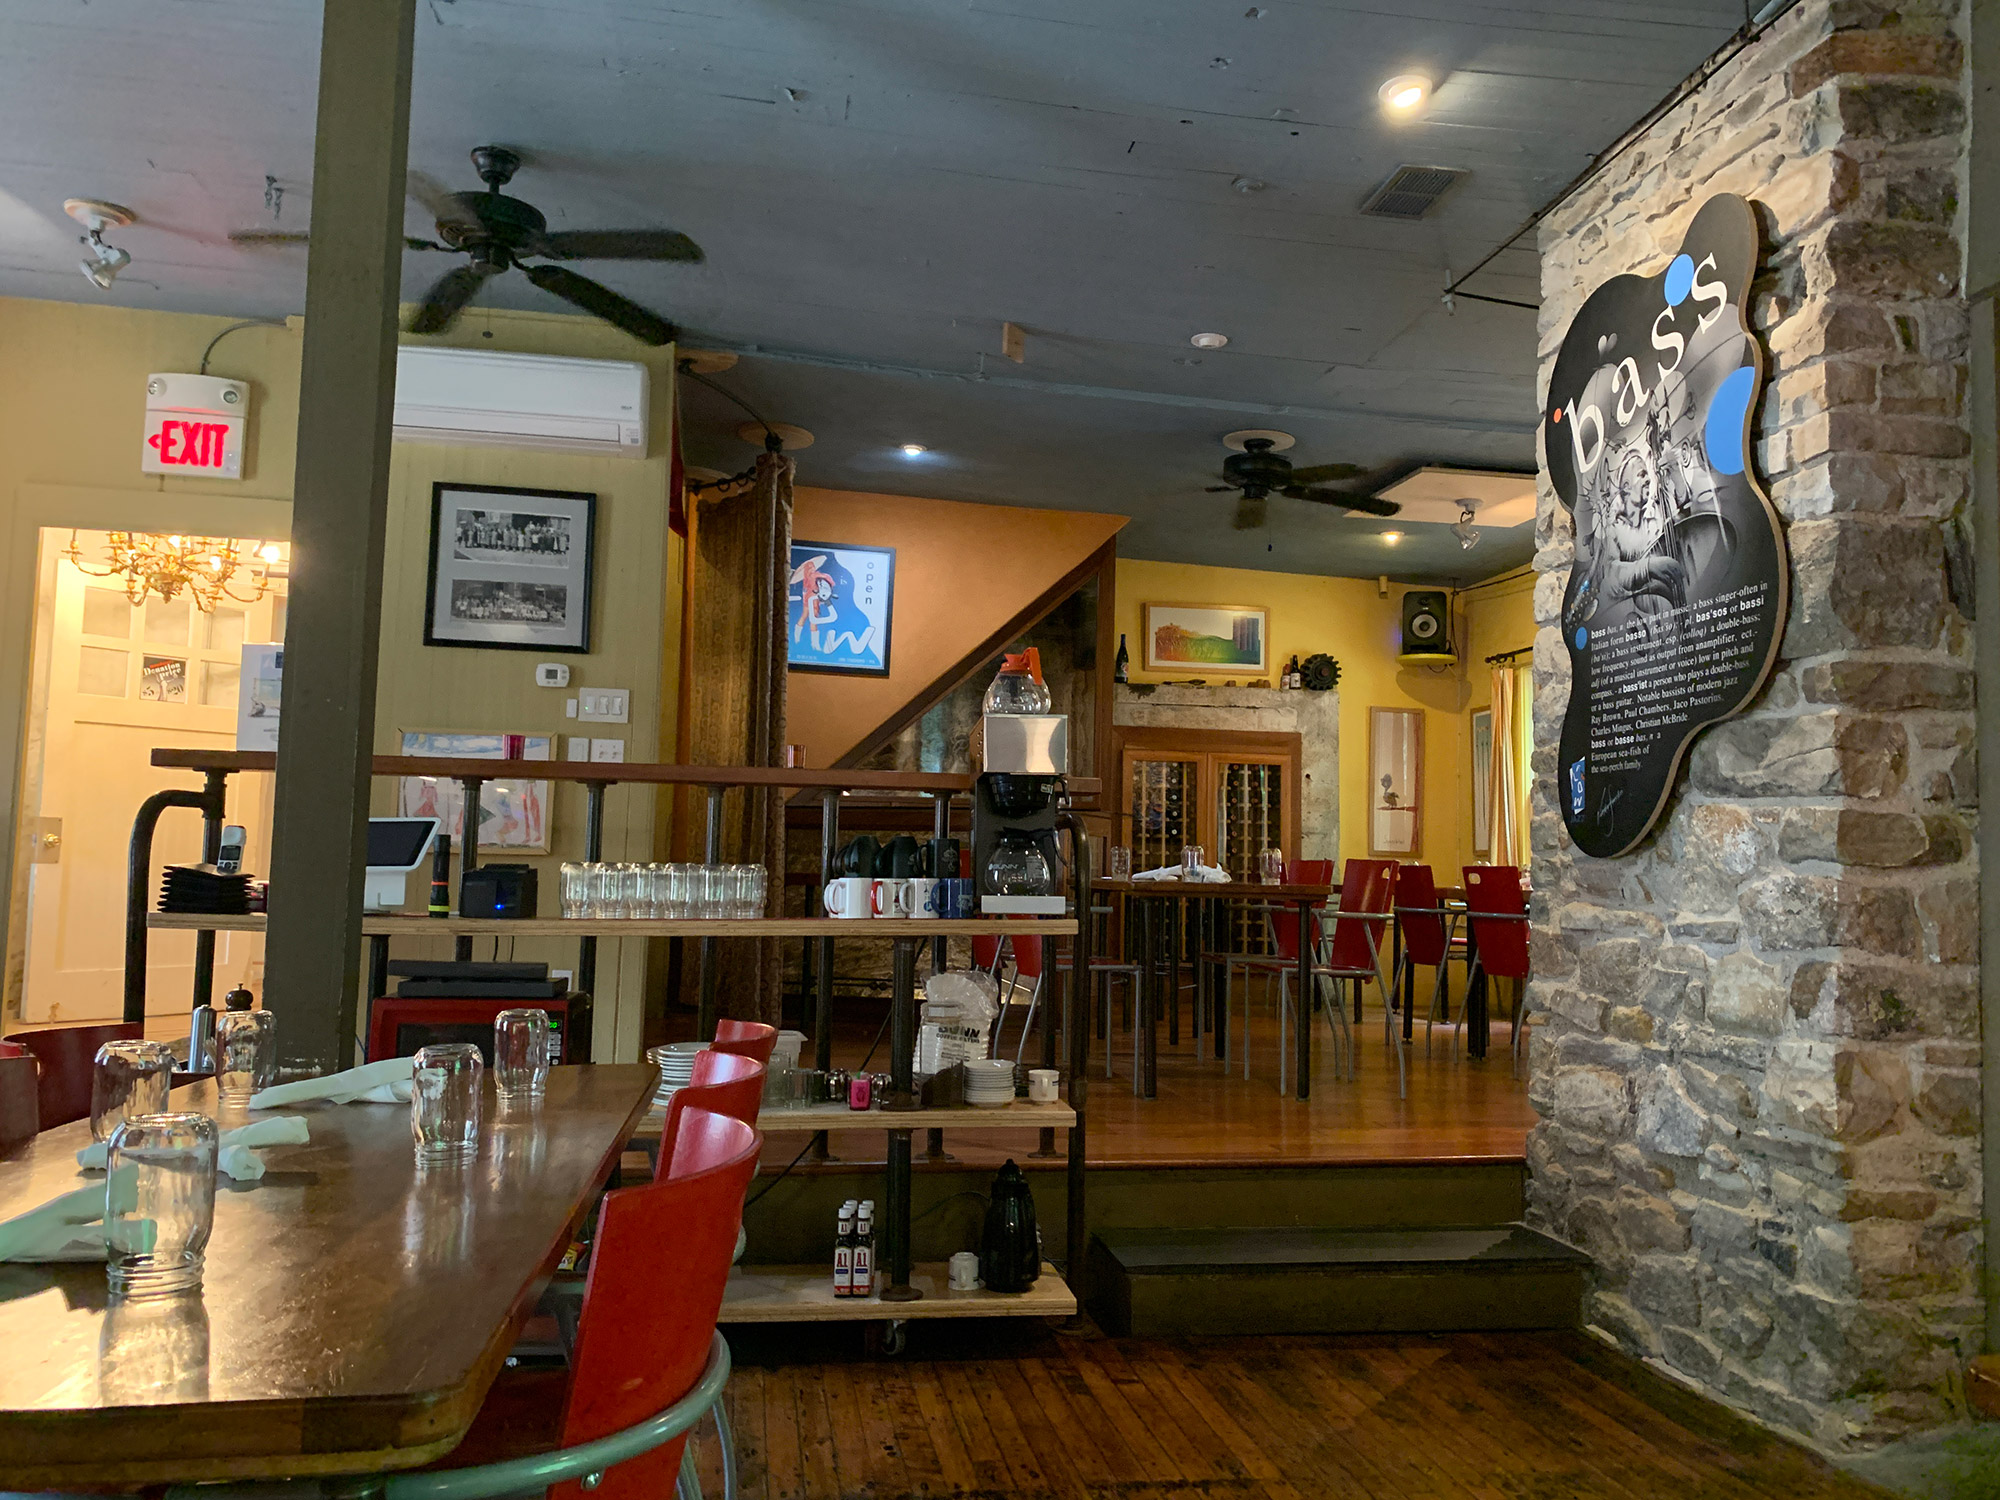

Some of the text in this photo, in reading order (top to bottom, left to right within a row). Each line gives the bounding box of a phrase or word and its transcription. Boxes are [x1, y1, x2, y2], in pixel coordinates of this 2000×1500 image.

[1563, 252, 1728, 474] bass
[160, 420, 230, 467] EXIT
[863, 562, 876, 605] open
[1591, 628, 1606, 639] bass
[1626, 619, 1636, 628] the
[1649, 612, 1661, 624] part
[1662, 609, 1669, 618] in
[1698, 598, 1714, 608] bass
[1715, 584, 1758, 604] singer-often
[1760, 580, 1768, 591] in
[1592, 640, 1609, 651] Italian
[1610, 636, 1624, 646] form
[1626, 630, 1646, 642] basso
[1696, 607, 1728, 622] bas'sos
[1730, 604, 1738, 614] or
[1740, 594, 1764, 610] bassi
[1590, 678, 1600, 688] adj
[1600, 675, 1609, 687] (of
[1614, 669, 1636, 682] musical
[1636, 663, 1668, 678] instrument
[1668, 662, 1676, 670] or
[1678, 656, 1698, 668] voice)
[1699, 654, 1711, 664] low
[1712, 650, 1720, 660] in
[1721, 646, 1738, 660] pitch
[1740, 642, 1754, 654] and
[1591, 667, 1601, 676] low
[1602, 660, 1629, 673] frequency
[1630, 654, 1648, 666] sound
[1656, 648, 1677, 660] output
[1678, 644, 1694, 655] from
[1616, 648, 1628, 657] bass
[1653, 676, 1672, 689] person
[1674, 672, 1686, 682] who
[1688, 670, 1704, 682] plays
[1710, 660, 1750, 674] double-bass
[1602, 701, 1614, 710] bass
[1637, 691, 1660, 704] Notable
[1662, 686, 1686, 698] bassists
[1687, 682, 1696, 694] of
[1696, 680, 1722, 692] modern
[1722, 676, 1738, 690] jazz
[1591, 716, 1601, 726] Ray
[1624, 708, 1638, 718] Paul
[1673, 700, 1688, 710] Jaco
[1591, 726, 1611, 737] Charles
[1636, 718, 1661, 730] Christian
[1591, 740, 1606, 749] bass
[1614, 736, 1634, 746] basse
[1592, 744, 1650, 762] European sea-fish of
[1600, 762, 1624, 773] sea-perch
